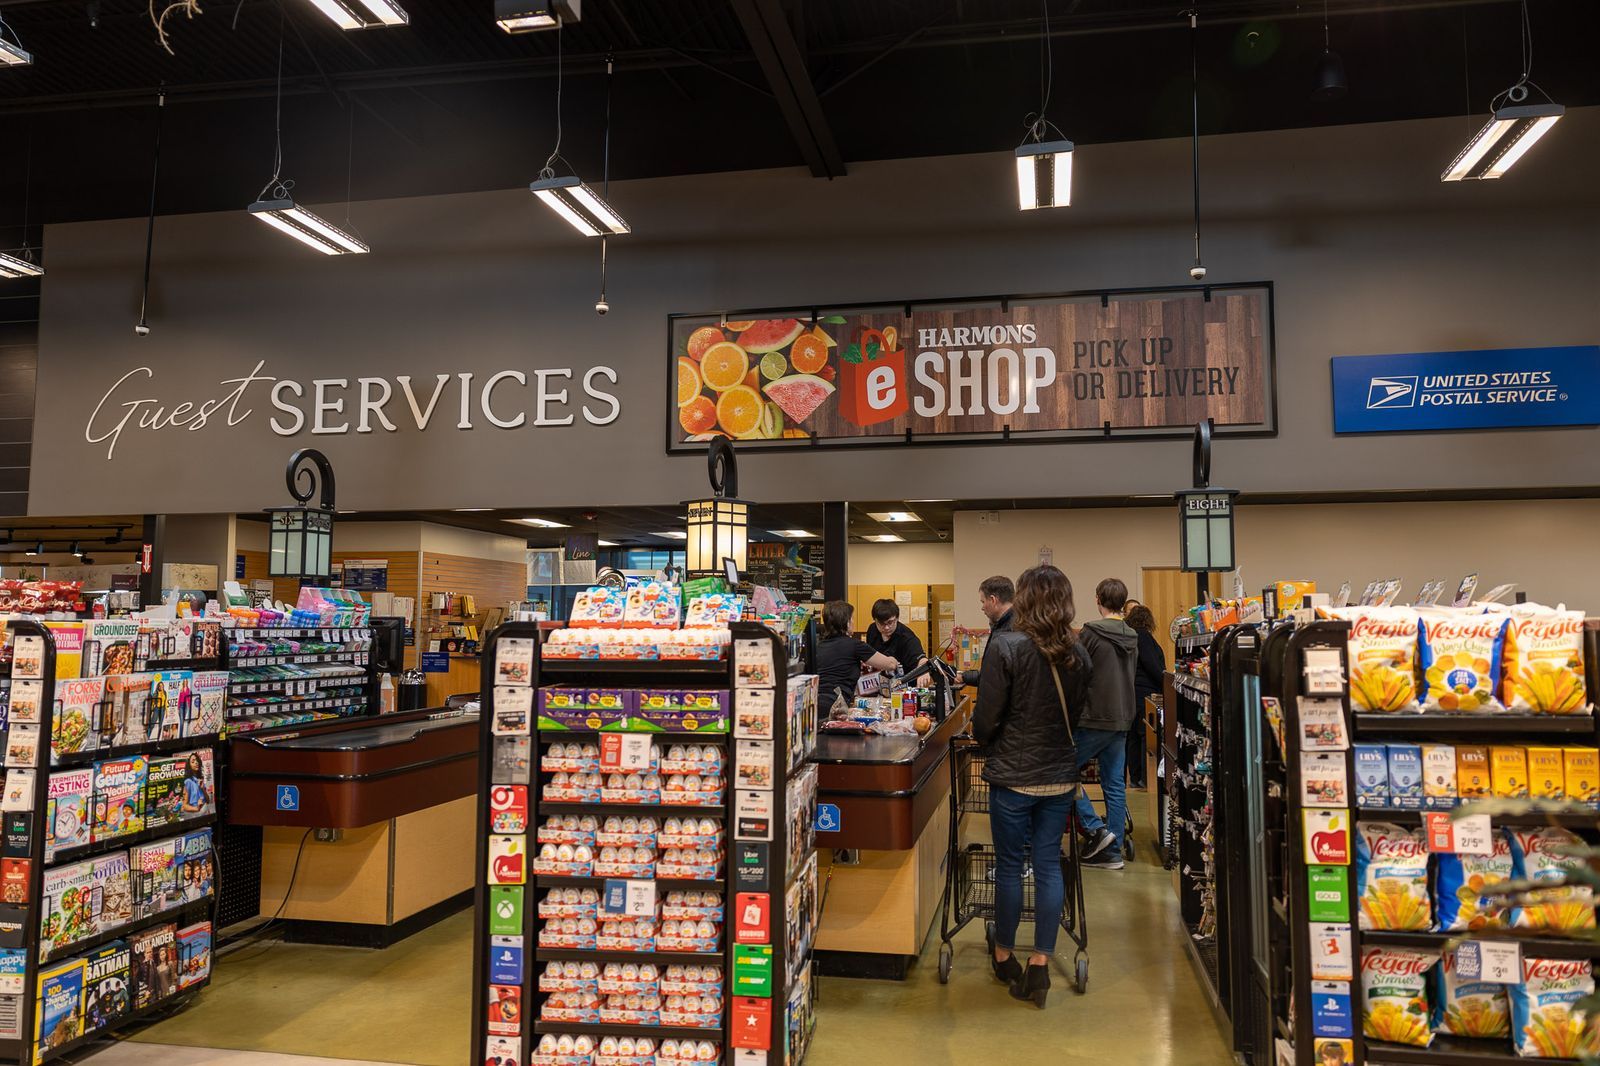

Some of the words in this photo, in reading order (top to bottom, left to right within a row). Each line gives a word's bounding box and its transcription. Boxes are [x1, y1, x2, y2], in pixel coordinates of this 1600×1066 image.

[918, 324, 1036, 348] HARMONS
[1073, 339, 1129, 369] PICK
[1141, 337, 1173, 366] UP
[866, 365, 896, 410] e
[914, 347, 1056, 418] SHOP
[1073, 371, 1105, 401] OR
[1117, 366, 1240, 399] DELIVERY
[1423, 373, 1488, 388] UNITED
[1490, 371, 1551, 386] STATES
[1420, 392, 1486, 406] POSTAL
[1486, 389, 1558, 403] SERVICE
[85, 360, 277, 460] Guest
[269, 366, 621, 436] SERVICES
[1189, 499, 1228, 510] EIGHT
[280, 515, 296, 526] SIX
[94, 625, 123, 636] GROUND
[124, 624, 139, 635] BEEF
[1348, 616, 1417, 640] Veggie
[1425, 620, 1499, 643] Veggie
[1510, 617, 1583, 640] Veggie
[68, 682, 102, 695] FORKS
[70, 693, 100, 704] KNIVES
[104, 763, 131, 774] Future
[149, 769, 185, 780] GROWING
[161, 763, 176, 772] GET
[49, 773, 90, 784] TERMITTENT
[95, 770, 136, 788] Genius
[102, 783, 138, 797] Weather
[144, 848, 165, 858] SMALL
[184, 834, 212, 856] ABBA
[144, 854, 165, 866] SPACE
[135, 931, 174, 955] OUTLANDER
[0, 954, 25, 966] appy
[86, 953, 130, 981] BATMAN
[736, 956, 769, 966] SUBWAY
[1360, 946, 1430, 976] Veggie
[1372, 973, 1415, 985] Straws
